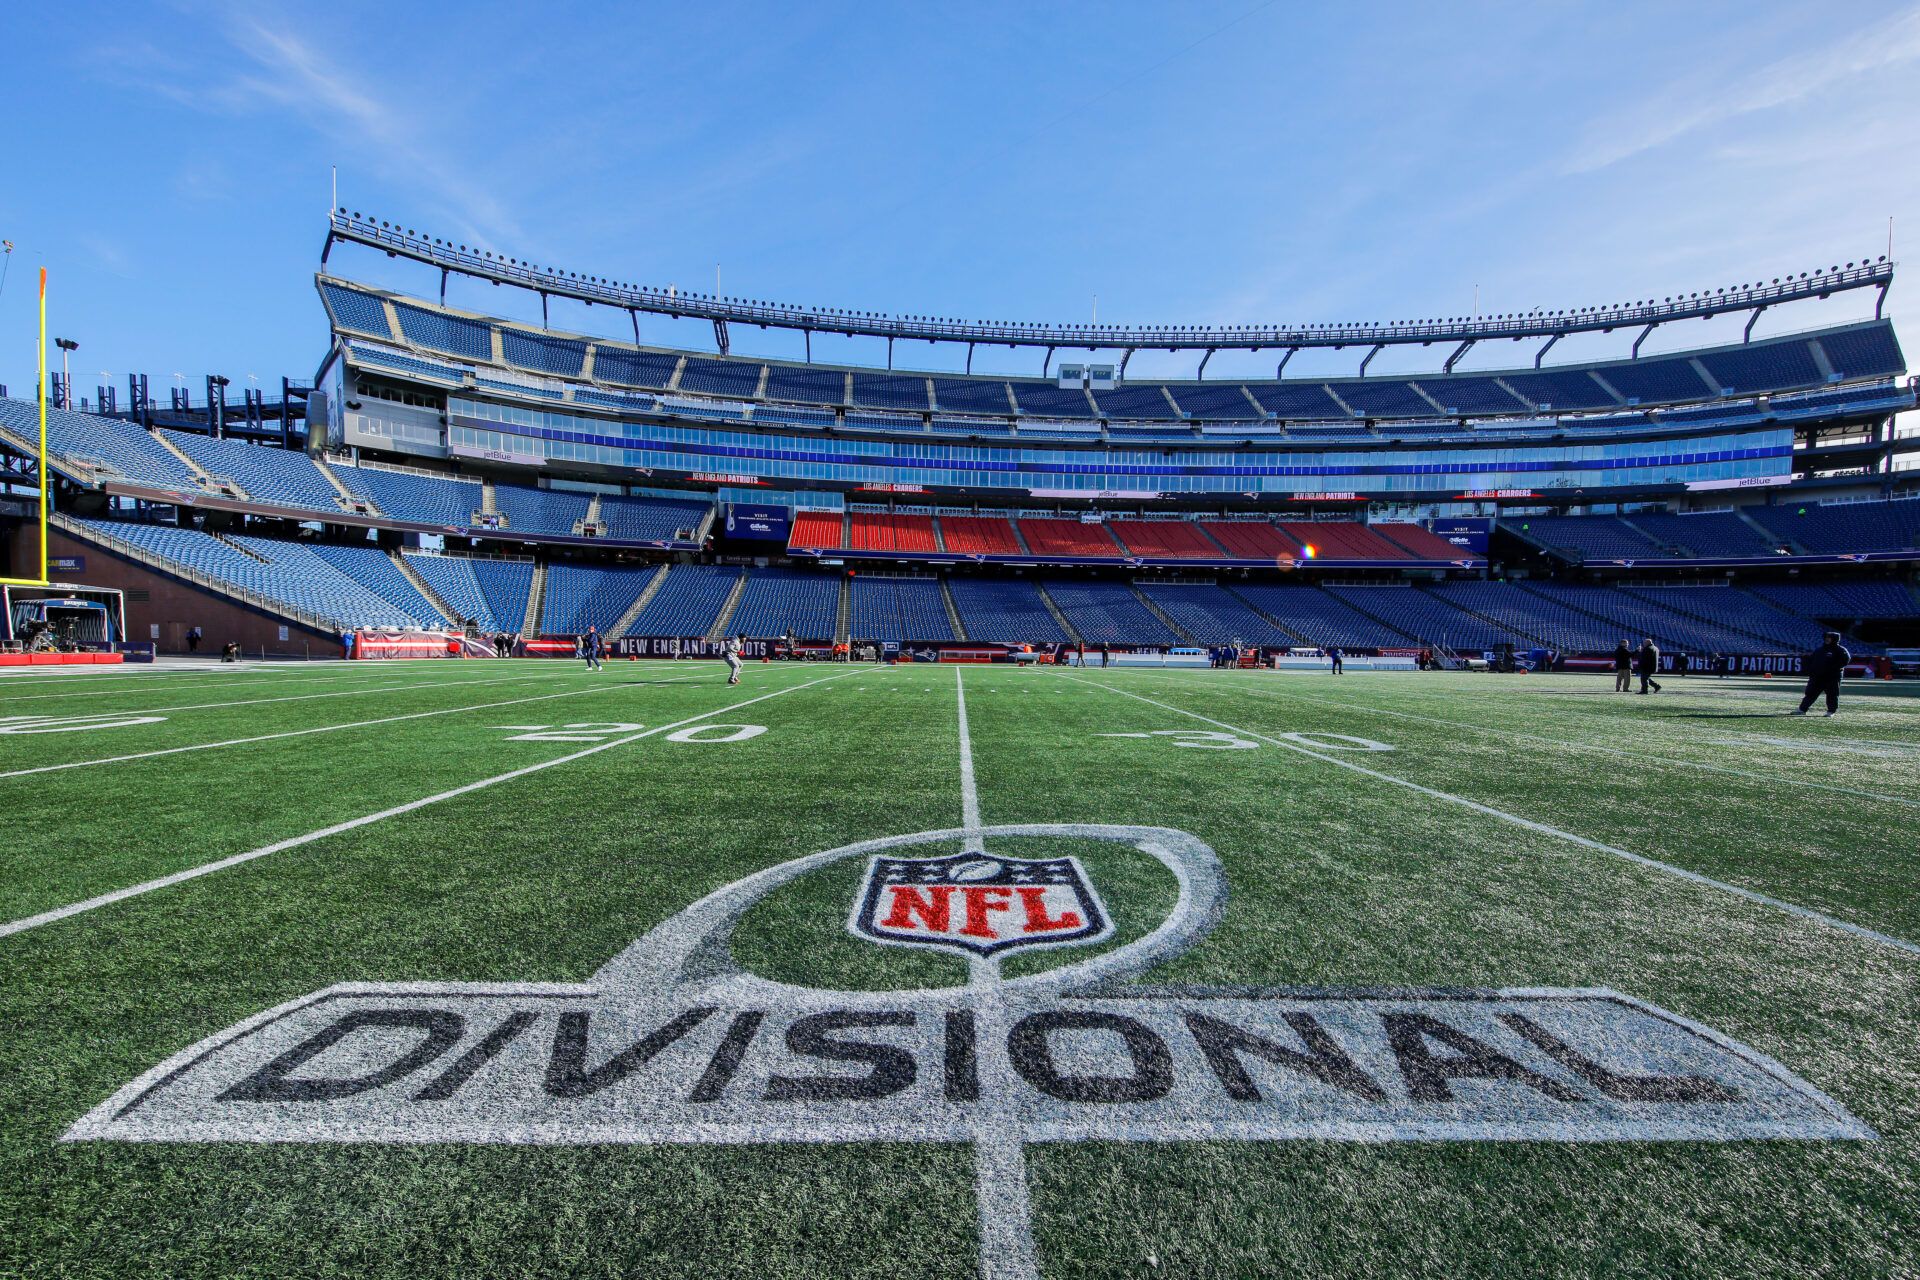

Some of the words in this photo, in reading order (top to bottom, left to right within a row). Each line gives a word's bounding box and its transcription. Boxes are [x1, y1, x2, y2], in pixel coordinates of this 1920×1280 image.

[483, 450, 512, 460] jetBlue
[692, 472, 705, 481] NEW
[704, 473, 727, 483] ENGLAND
[727, 474, 759, 484] PATRIOTS
[1739, 478, 1771, 487] jetBlue
[863, 482, 872, 490] LOS
[872, 483, 892, 491] ANGELES
[893, 484, 923, 492] CHARGERS
[1293, 492, 1305, 500] NEW
[1304, 492, 1325, 500] ENGLAND
[1325, 492, 1356, 500] PATRIOTS
[1464, 490, 1474, 498] LOS
[1474, 490, 1495, 498] ANGELES
[1497, 489, 1532, 498] CHARGERS
[620, 639, 648, 654] NEW
[1741, 657, 1801, 671] PATRIOTS
[881, 886, 1081, 939] NFL
[216, 1009, 1738, 1104] DIVISIONAL
